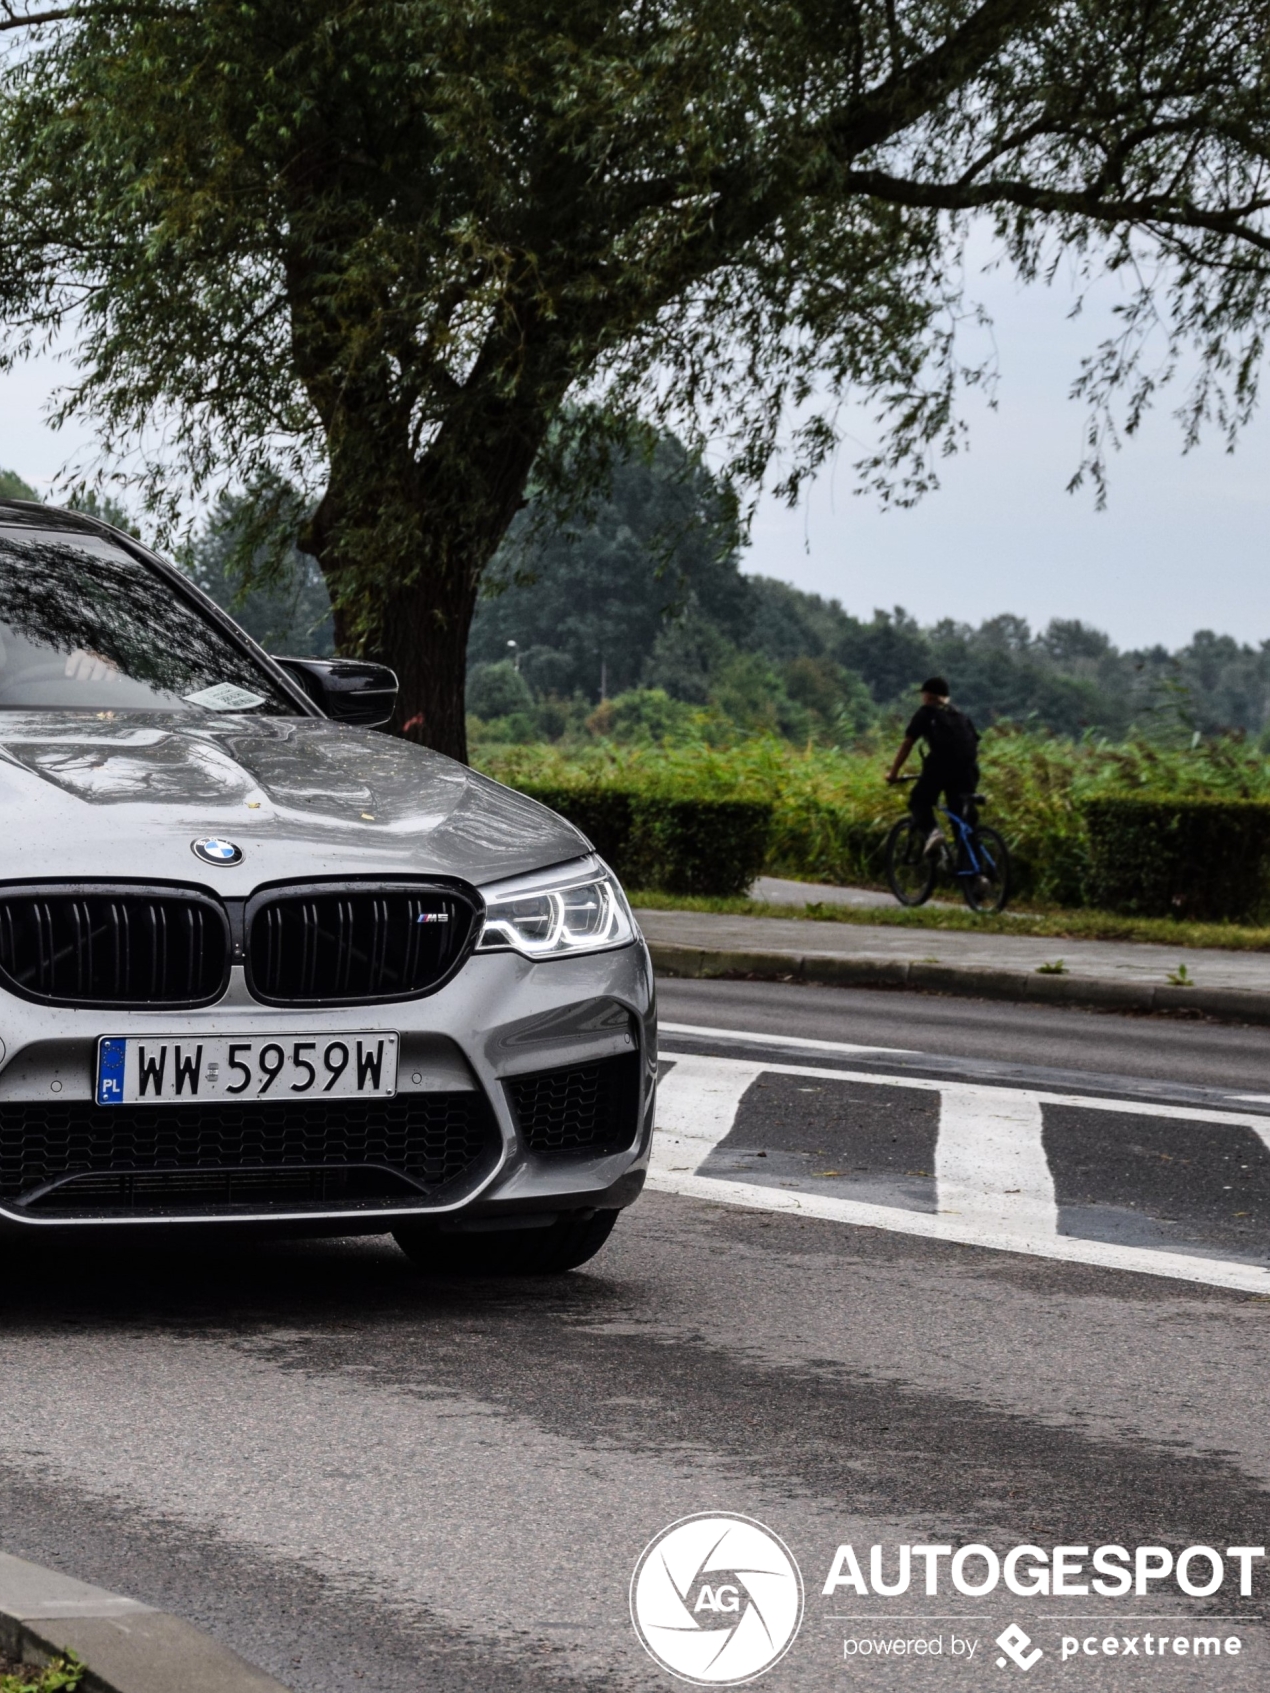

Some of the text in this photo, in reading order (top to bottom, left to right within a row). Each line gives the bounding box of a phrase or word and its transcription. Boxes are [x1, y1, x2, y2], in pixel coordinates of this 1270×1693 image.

[426, 913, 449, 922] M5
[138, 1039, 385, 1096] WW 5959W
[102, 1078, 120, 1094] PL
